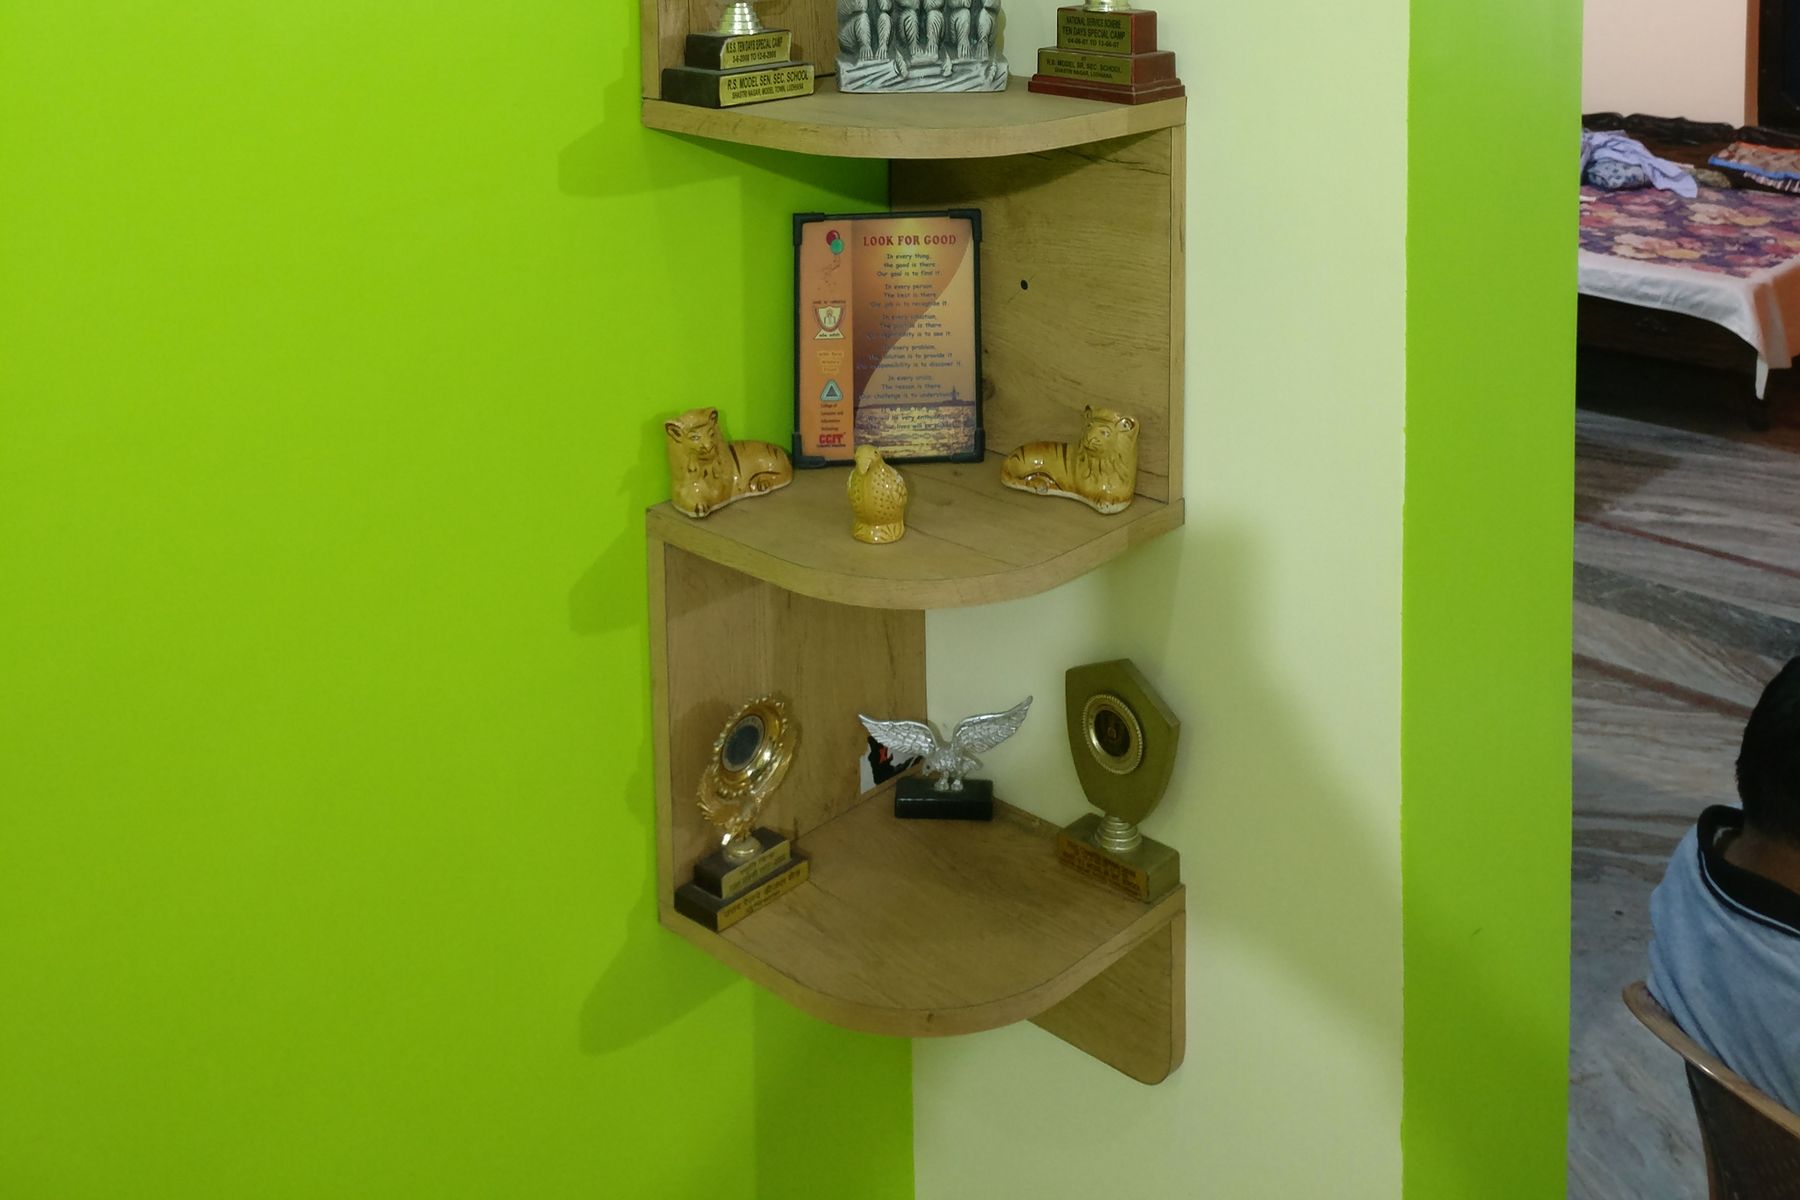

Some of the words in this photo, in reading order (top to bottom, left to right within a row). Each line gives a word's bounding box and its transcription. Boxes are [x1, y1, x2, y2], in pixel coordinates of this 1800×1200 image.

[740, 76, 758, 89] MODEL
[786, 70, 809, 83] SCHOOL
[863, 236, 894, 247] LOOK
[898, 236, 920, 246] FOR
[924, 235, 957, 245] GOOD
